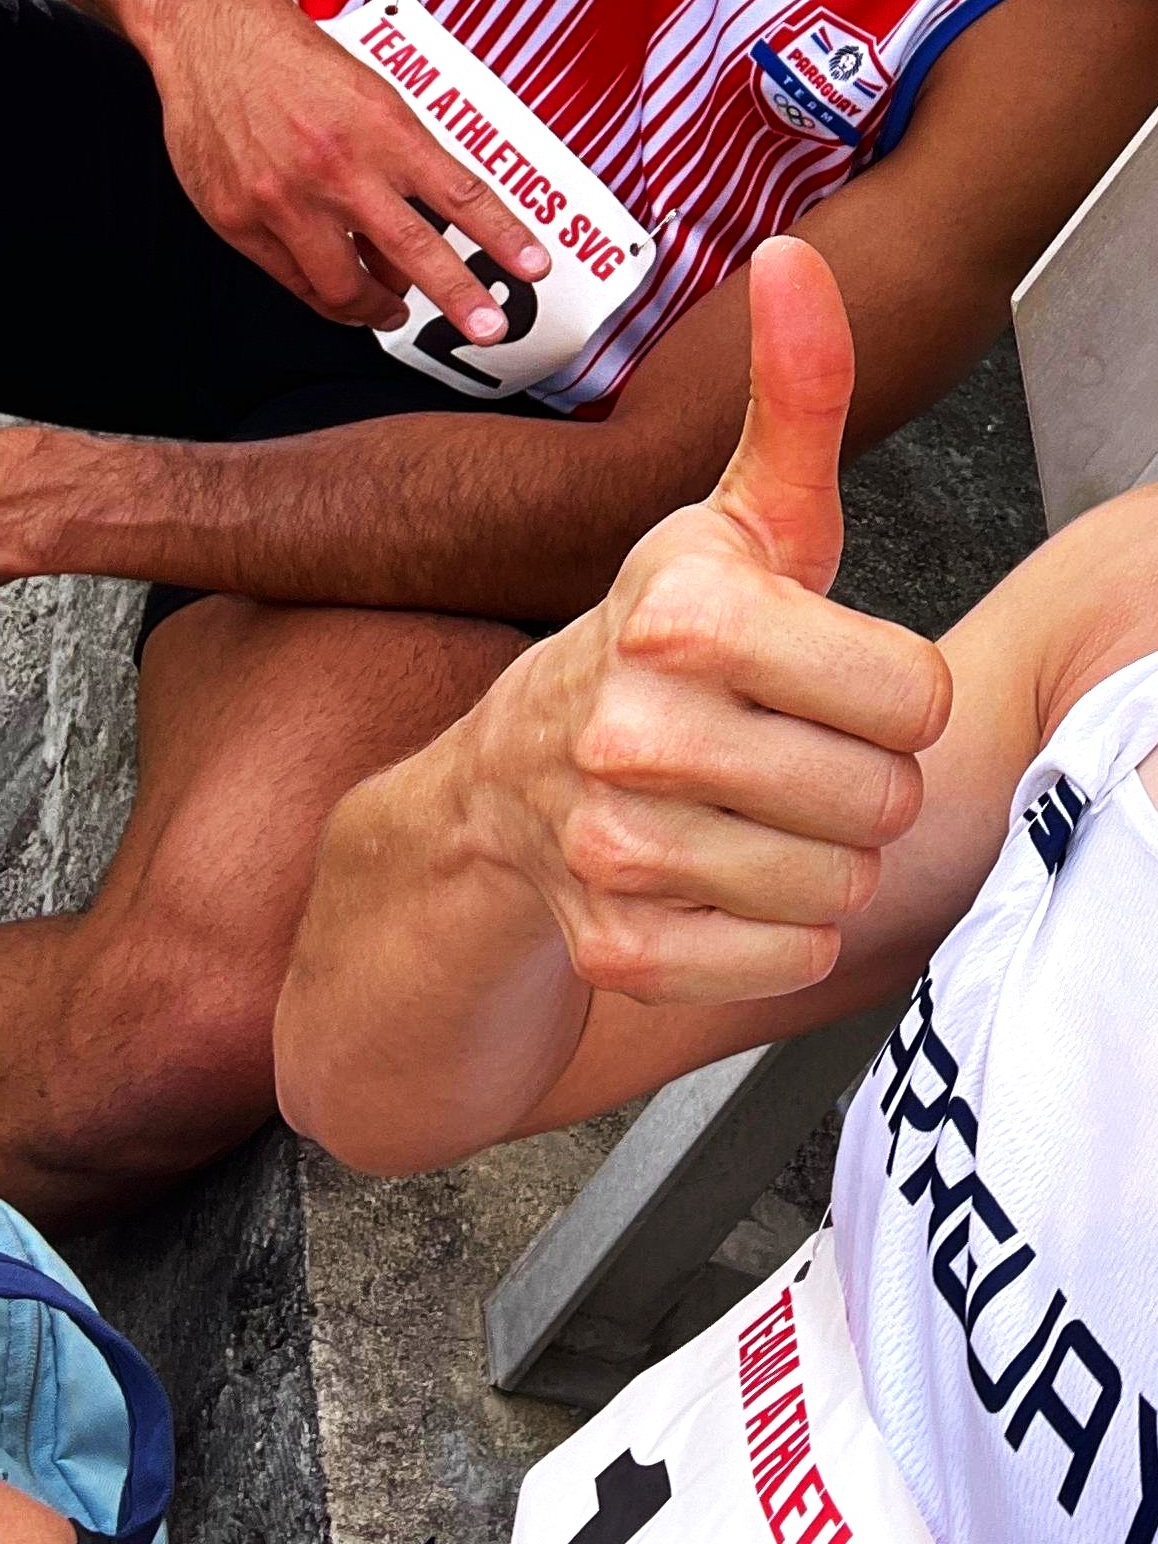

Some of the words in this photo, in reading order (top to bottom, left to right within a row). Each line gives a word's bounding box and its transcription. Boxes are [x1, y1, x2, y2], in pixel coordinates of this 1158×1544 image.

[783, 74, 834, 123] TEAM
[787, 48, 862, 118] PARAGUAY
[359, 17, 441, 99] TEAM
[426, 86, 567, 225] ATHLETICS
[558, 213, 626, 282] SVG
[739, 1286, 801, 1410] TEAM
